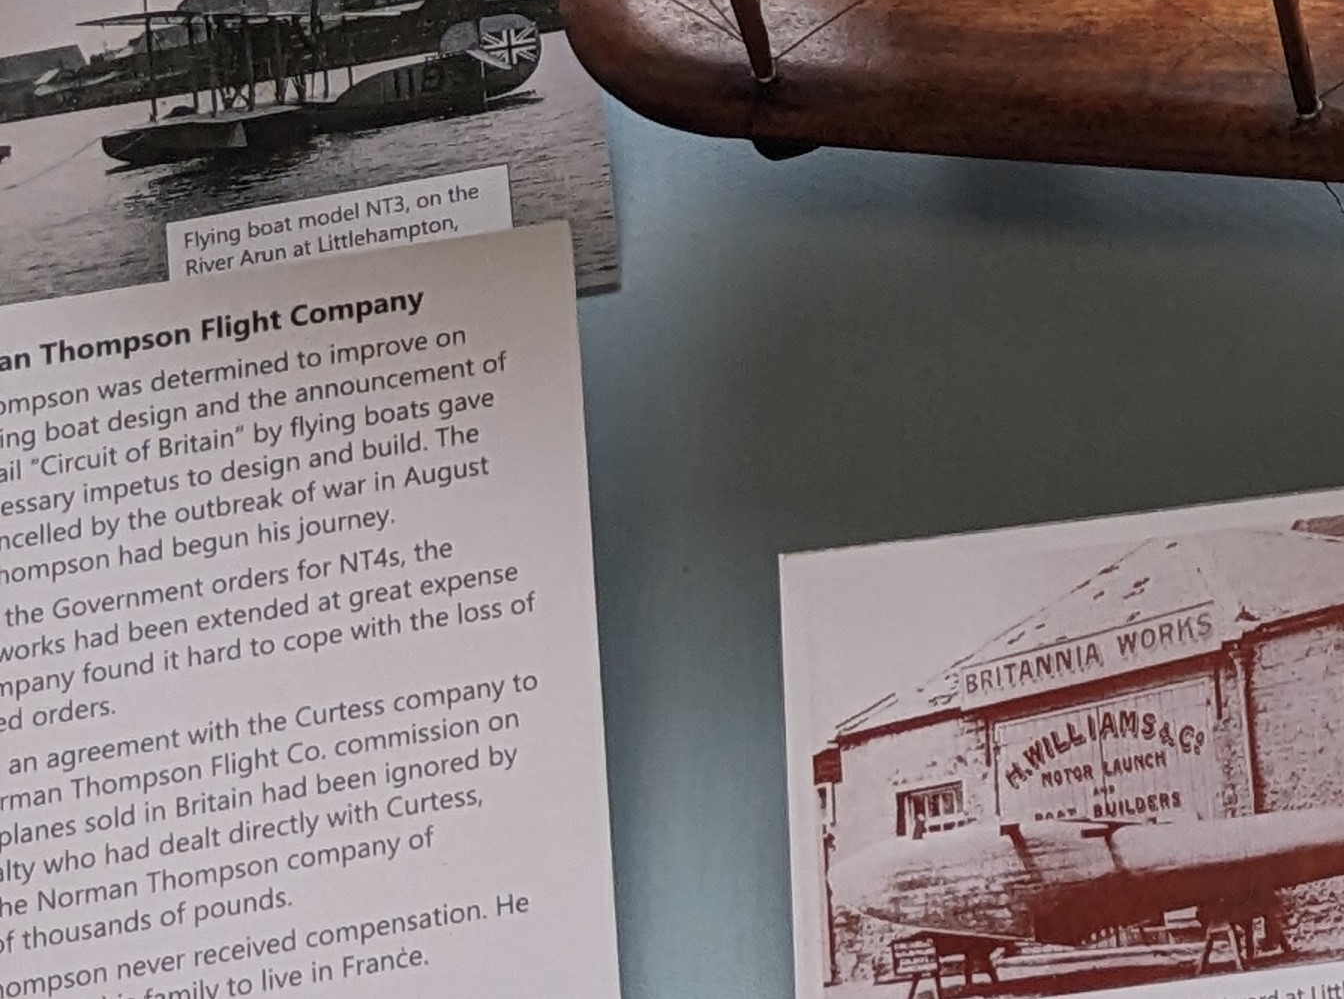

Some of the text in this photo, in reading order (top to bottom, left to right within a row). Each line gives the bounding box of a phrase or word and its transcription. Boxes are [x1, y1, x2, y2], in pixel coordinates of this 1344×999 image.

[183, 185, 479, 252] Flying boat model NT3, on the
[184, 217, 459, 277] River Arun at Littlehampton,
[38, 326, 191, 366] Thompson
[200, 309, 283, 343] Flight
[289, 290, 425, 327] Company
[3, 538, 453, 628] the Government orders for NT4s, the
[964, 612, 1213, 694] BRITANNIA WORKS
[8, 673, 538, 775] an agreement with the Curtess company to
[1041, 750, 1168, 788] MOTOR LAUNCH
[1092, 791, 1182, 819] BUILDERS
[20, 886, 293, 950] thousands of pounds.
